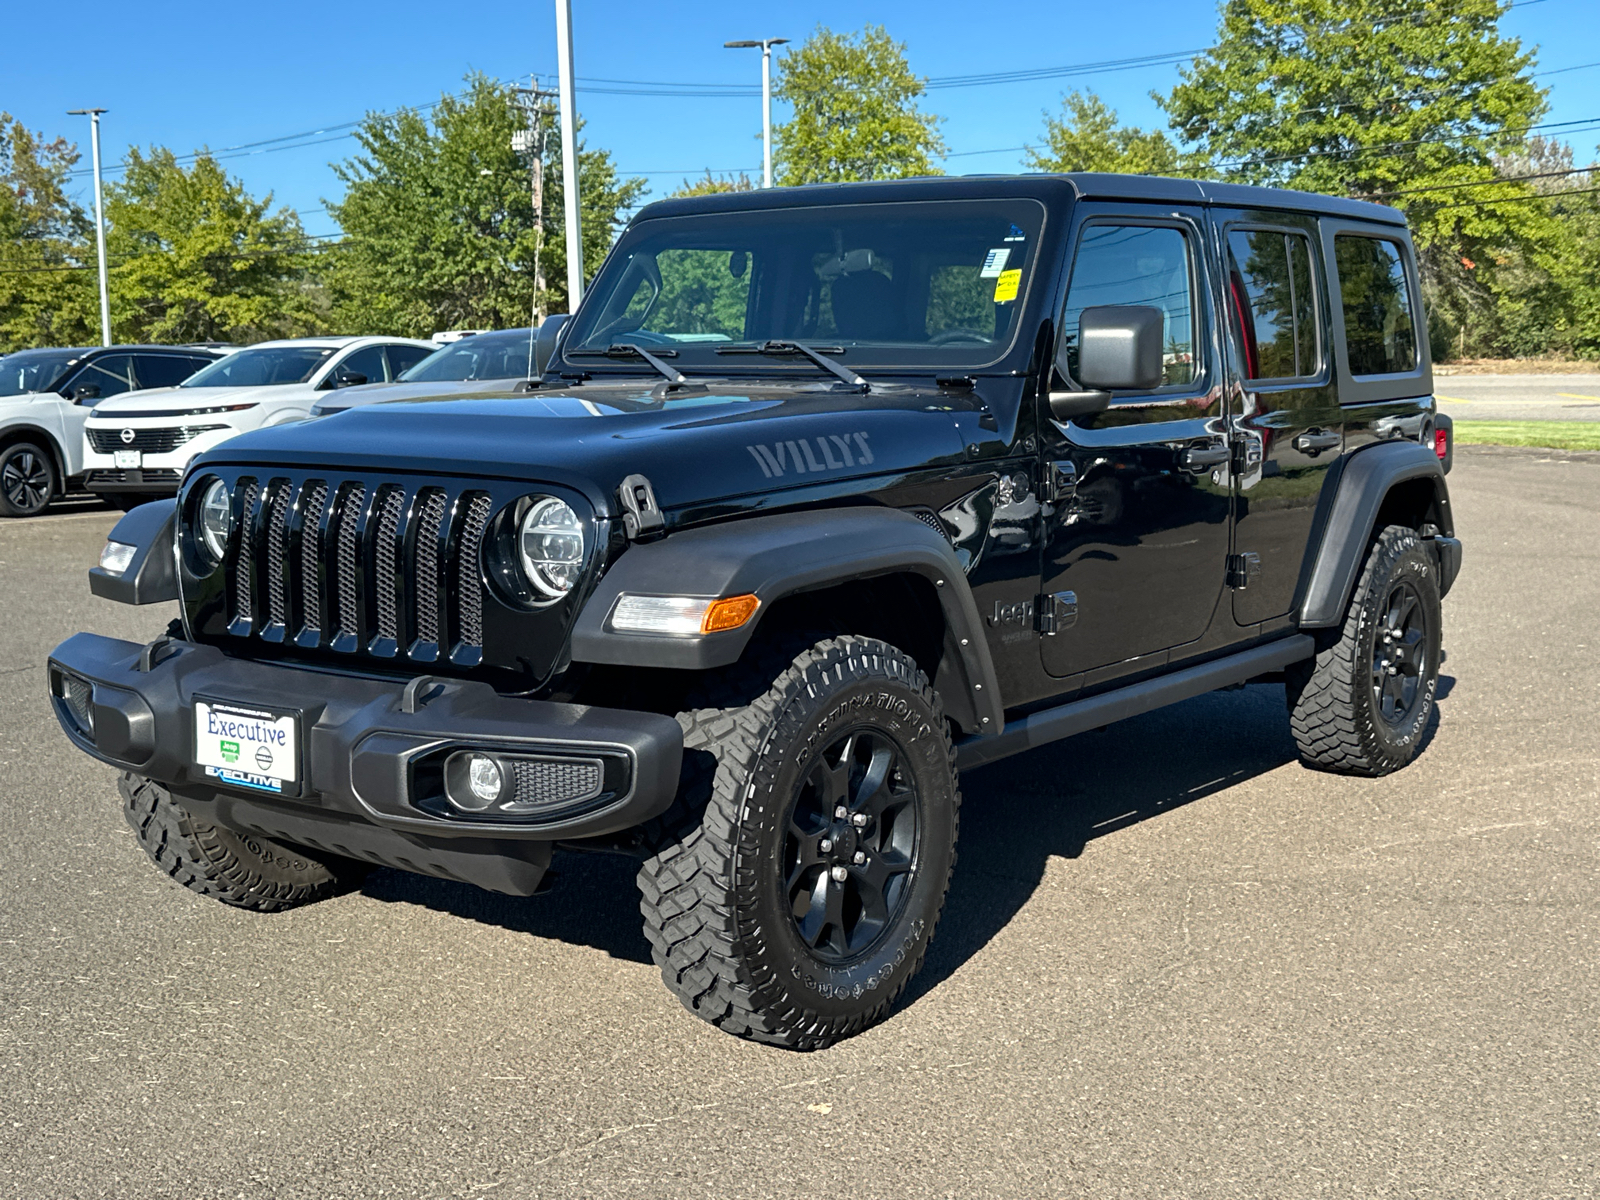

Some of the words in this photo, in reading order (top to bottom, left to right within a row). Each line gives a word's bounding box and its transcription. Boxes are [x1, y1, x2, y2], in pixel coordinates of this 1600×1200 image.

[746, 431, 875, 478] WILLYS
[986, 600, 1034, 627] Jeep
[207, 711, 287, 747] Executive
[222, 741, 239, 753] Jeep
[205, 765, 282, 789] EXECUTIVE
